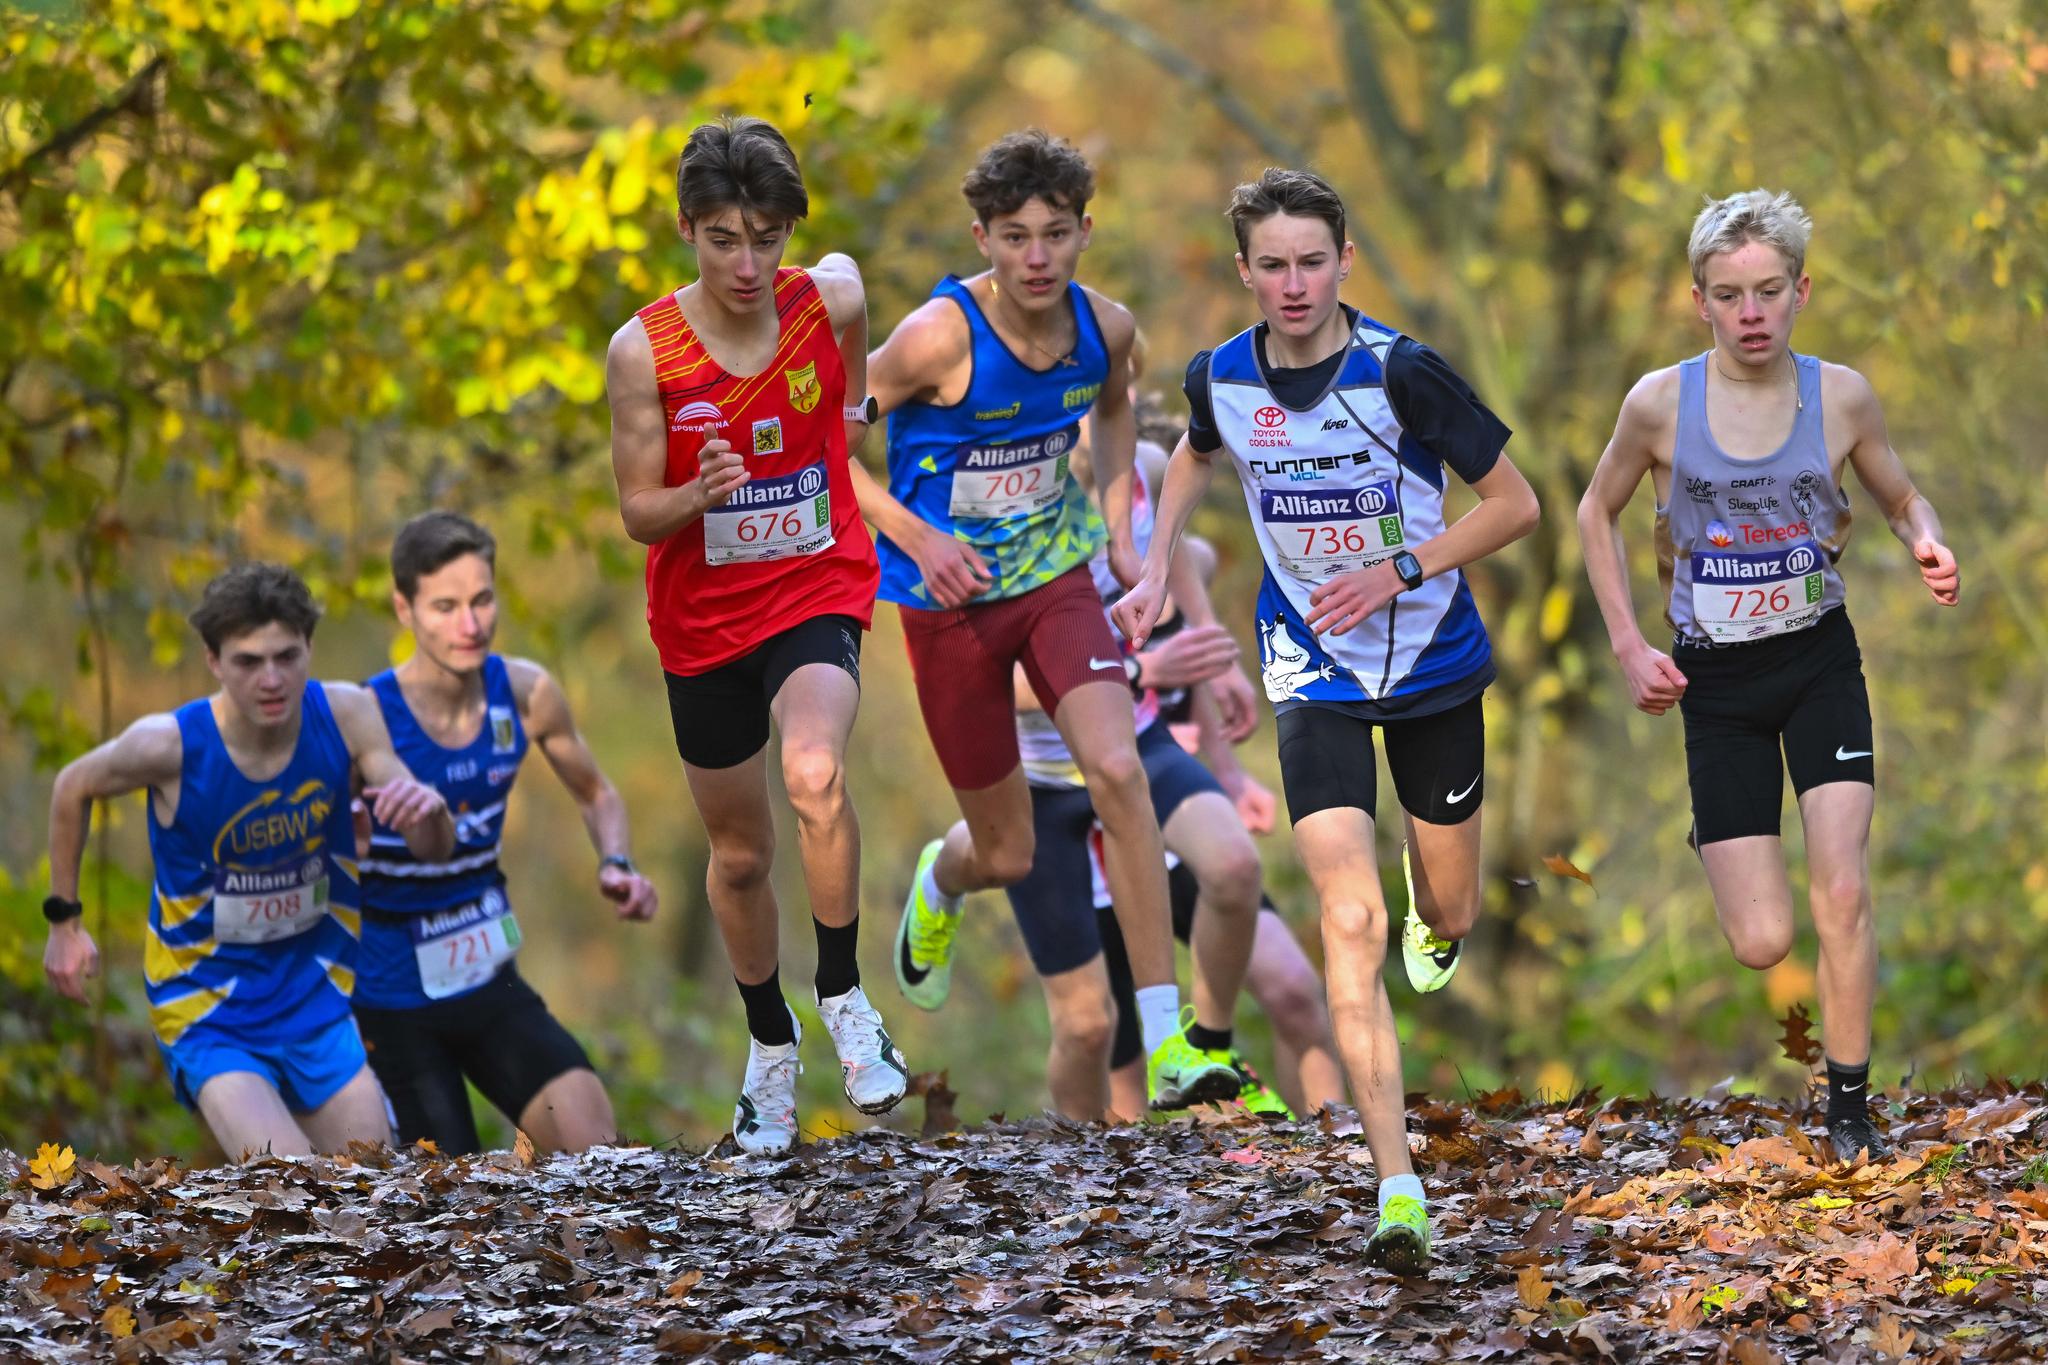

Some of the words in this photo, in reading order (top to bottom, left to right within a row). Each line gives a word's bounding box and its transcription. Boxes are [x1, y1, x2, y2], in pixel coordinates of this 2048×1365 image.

[671, 420, 731, 432] SPORTANA
[966, 442, 1040, 467] Allianz
[1249, 439, 1276, 448] COOLS
[1277, 439, 1293, 447] N.V.
[1249, 450, 1371, 474] runners
[985, 467, 1041, 500] 702
[1290, 472, 1325, 482] MOL
[1731, 477, 1767, 488] CRAFT
[726, 482, 794, 506] llianz
[1272, 495, 1352, 516] Allianz
[1728, 496, 1780, 512] Sleeplife
[818, 496, 827, 524] 2025
[737, 509, 802, 542] 676
[1383, 517, 1399, 544] 2025
[1739, 520, 1809, 545] Tereos
[797, 535, 827, 551] DOMO
[1297, 524, 1365, 556] 736
[1702, 557, 1782, 578] Allianz
[1810, 575, 1820, 601] 2025
[1724, 585, 1790, 619] 726
[231, 808, 309, 854] USBW
[224, 871, 298, 893] Allianz
[245, 893, 302, 925] 708
[443, 928, 493, 968] 721
